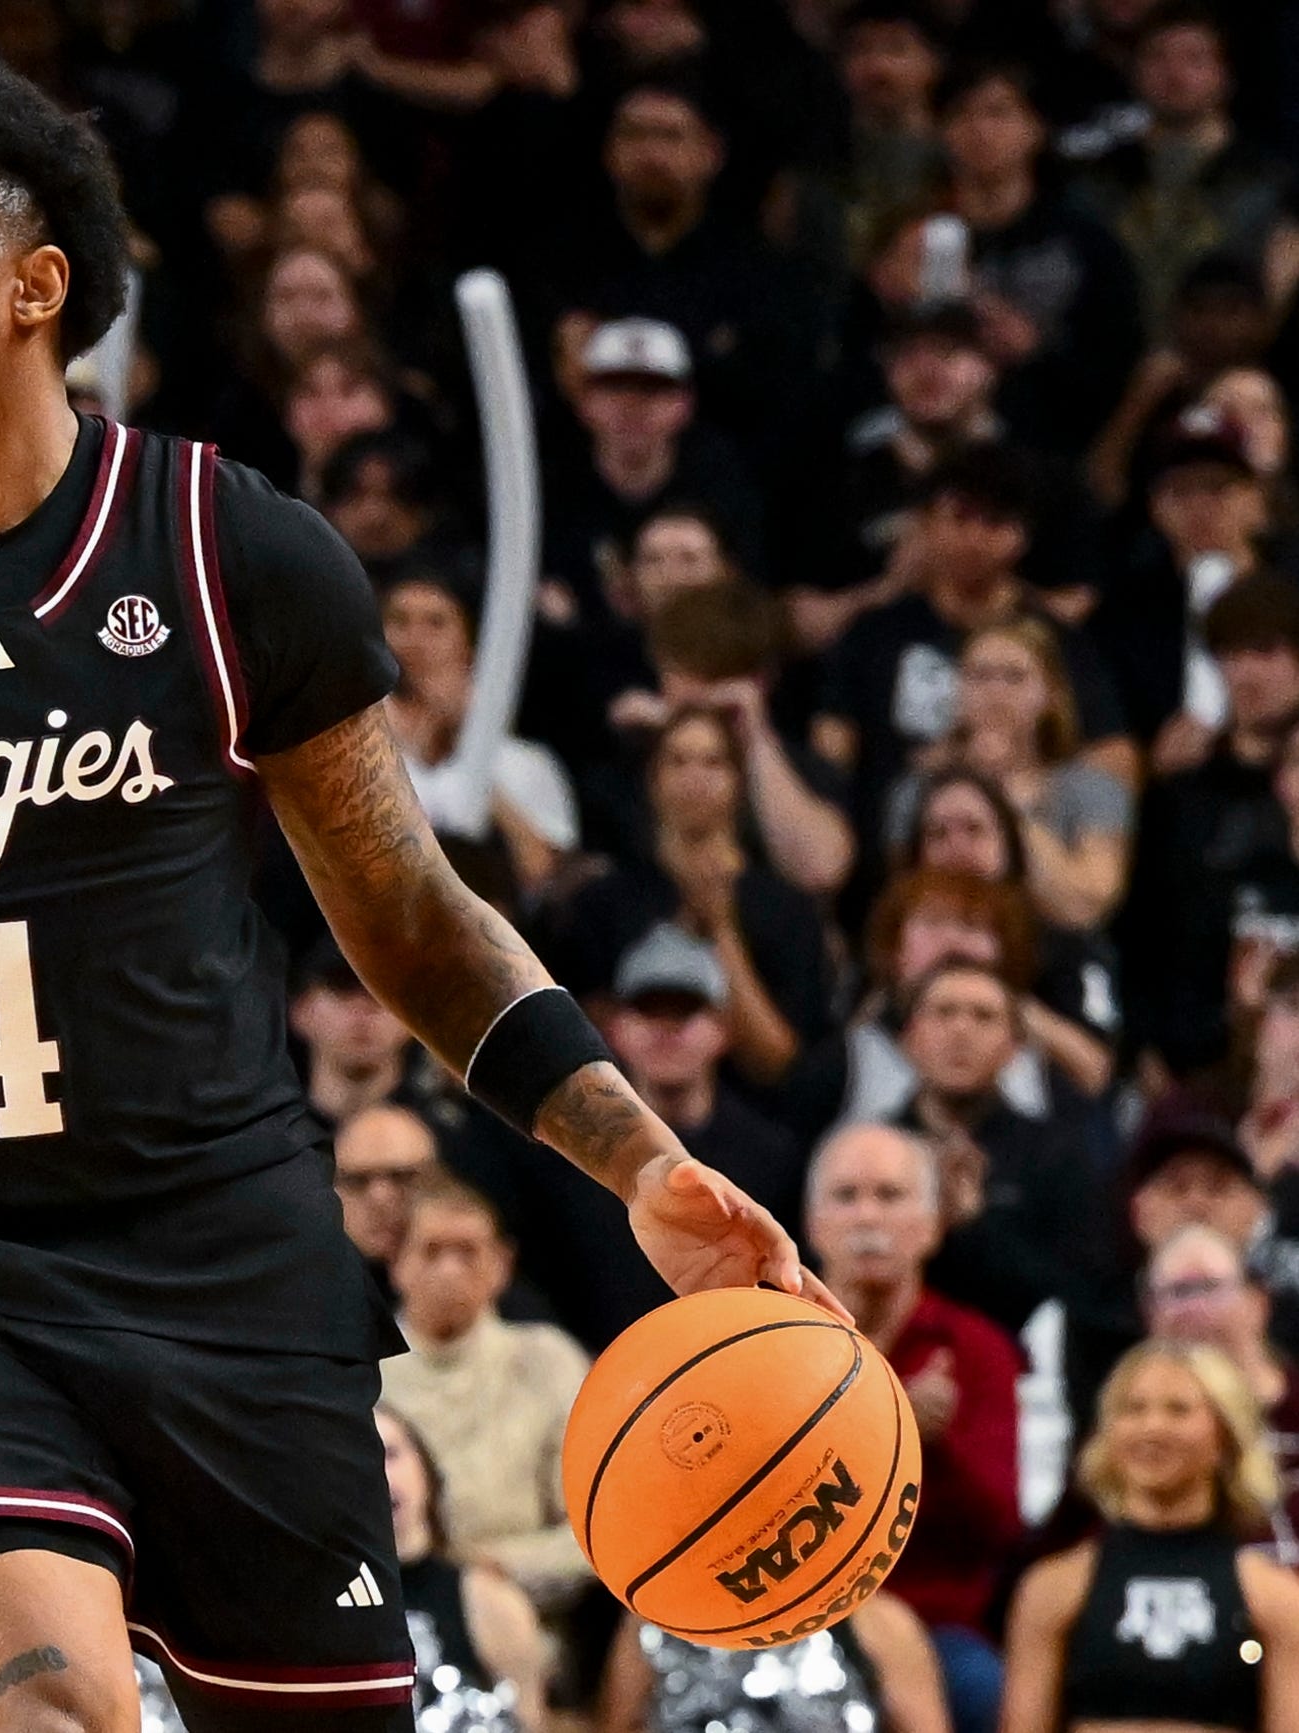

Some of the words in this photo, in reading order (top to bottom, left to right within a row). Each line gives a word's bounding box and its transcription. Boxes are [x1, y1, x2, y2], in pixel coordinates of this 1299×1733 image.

[111, 598, 155, 640] SEC
[105, 636, 163, 656] GRADUATE
[715, 1456, 864, 1604] NCAA
